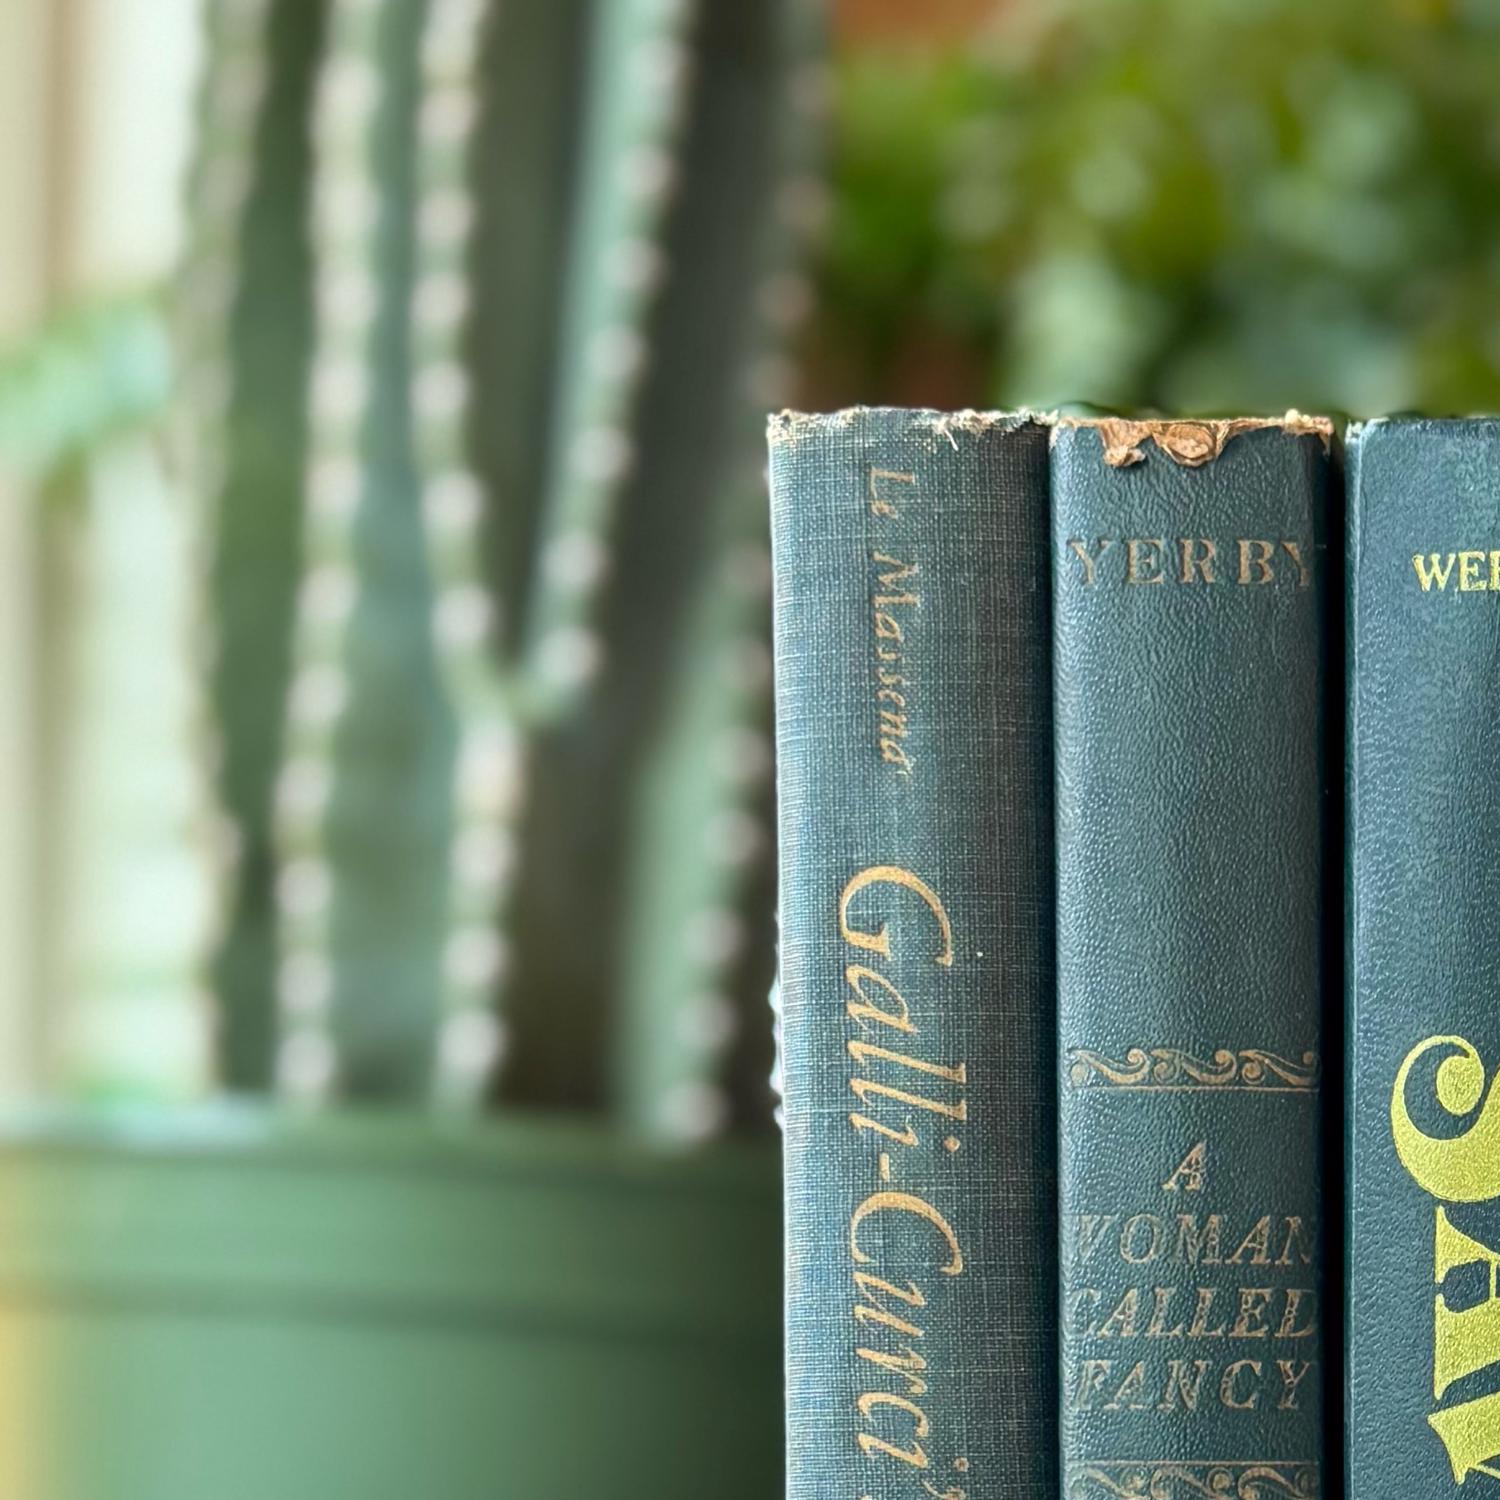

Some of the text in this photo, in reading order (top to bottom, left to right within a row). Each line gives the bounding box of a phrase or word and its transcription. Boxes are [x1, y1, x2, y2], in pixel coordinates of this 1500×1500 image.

[868, 465, 916, 520] Le
[1066, 537, 1311, 588] YERBY
[1162, 1142, 1208, 1192] A
[1074, 1358, 1314, 1411] FANCY
